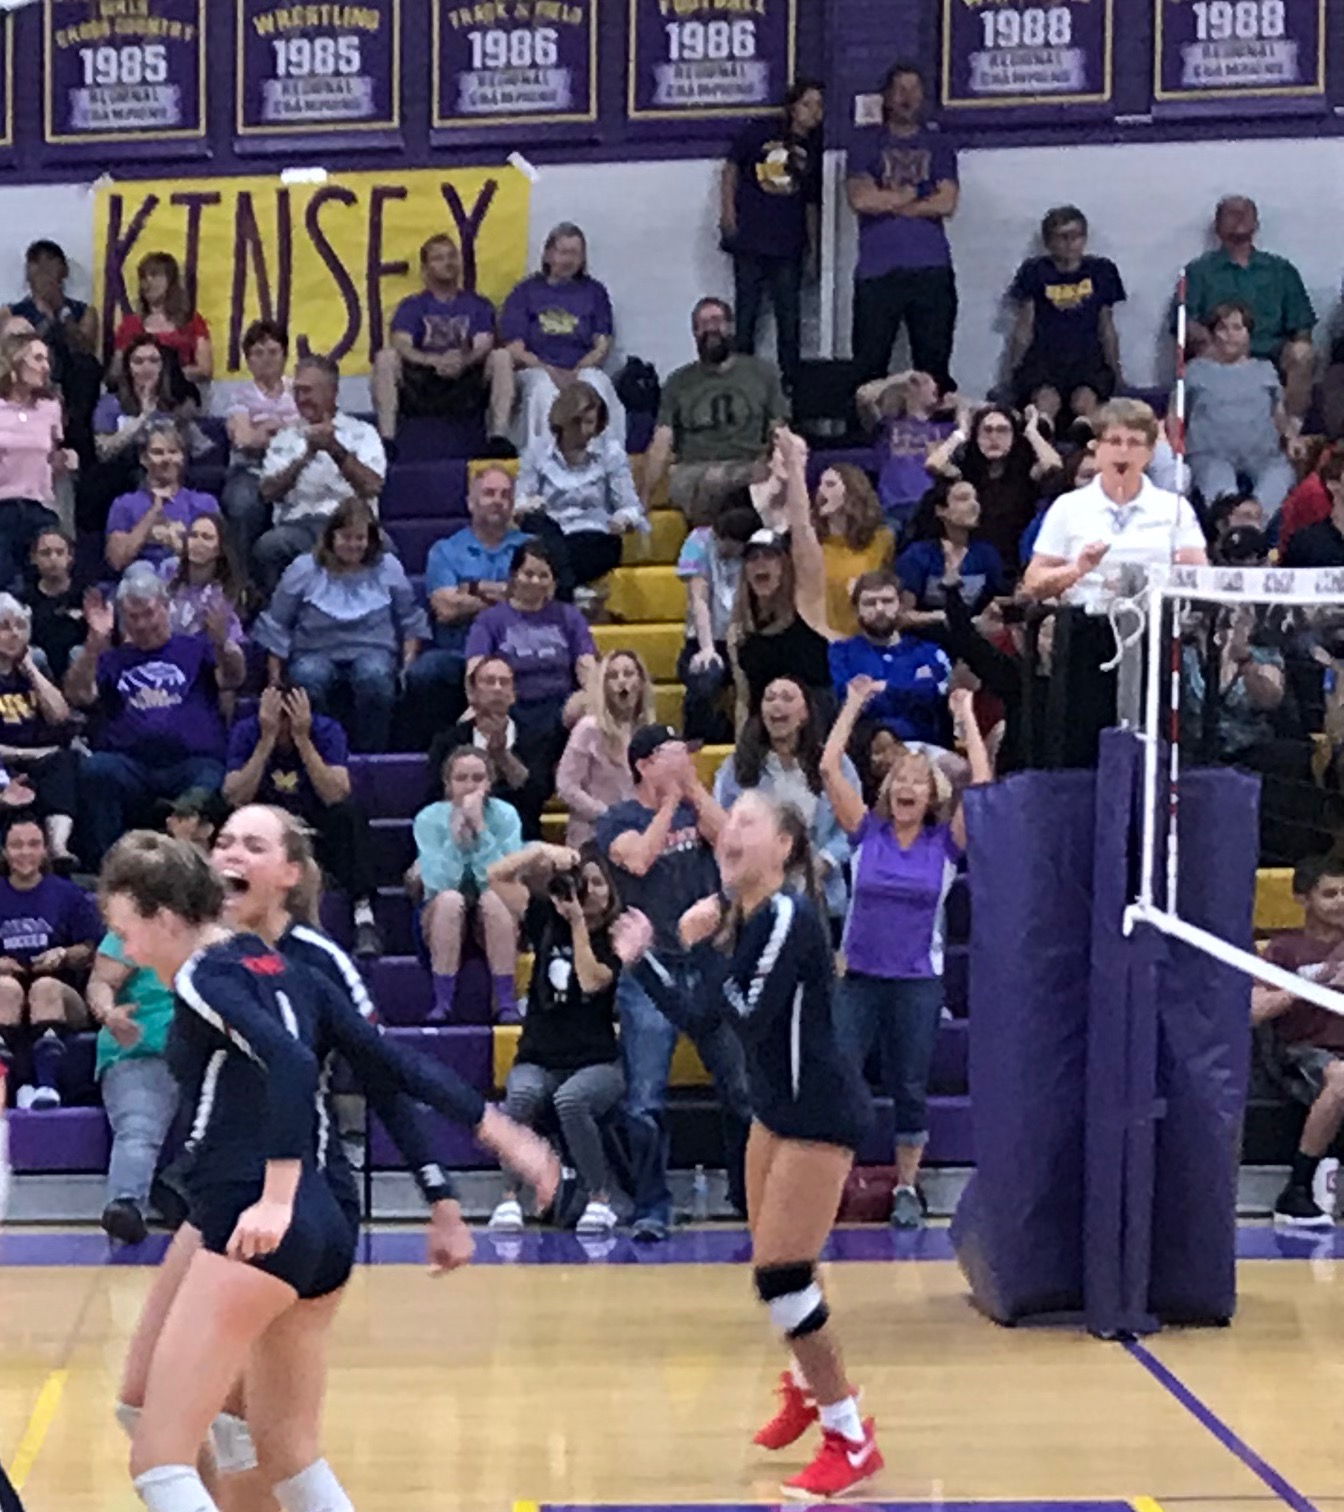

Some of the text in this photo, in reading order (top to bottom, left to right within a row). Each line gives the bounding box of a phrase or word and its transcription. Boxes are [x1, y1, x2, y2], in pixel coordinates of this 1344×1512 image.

[665, 20, 756, 60] 1986
[979, 7, 1072, 47] 1988
[1193, 1, 1286, 40] 1988
[79, 45, 167, 85] 1985
[273, 36, 360, 76] 1985
[467, 27, 558, 68] 1986
